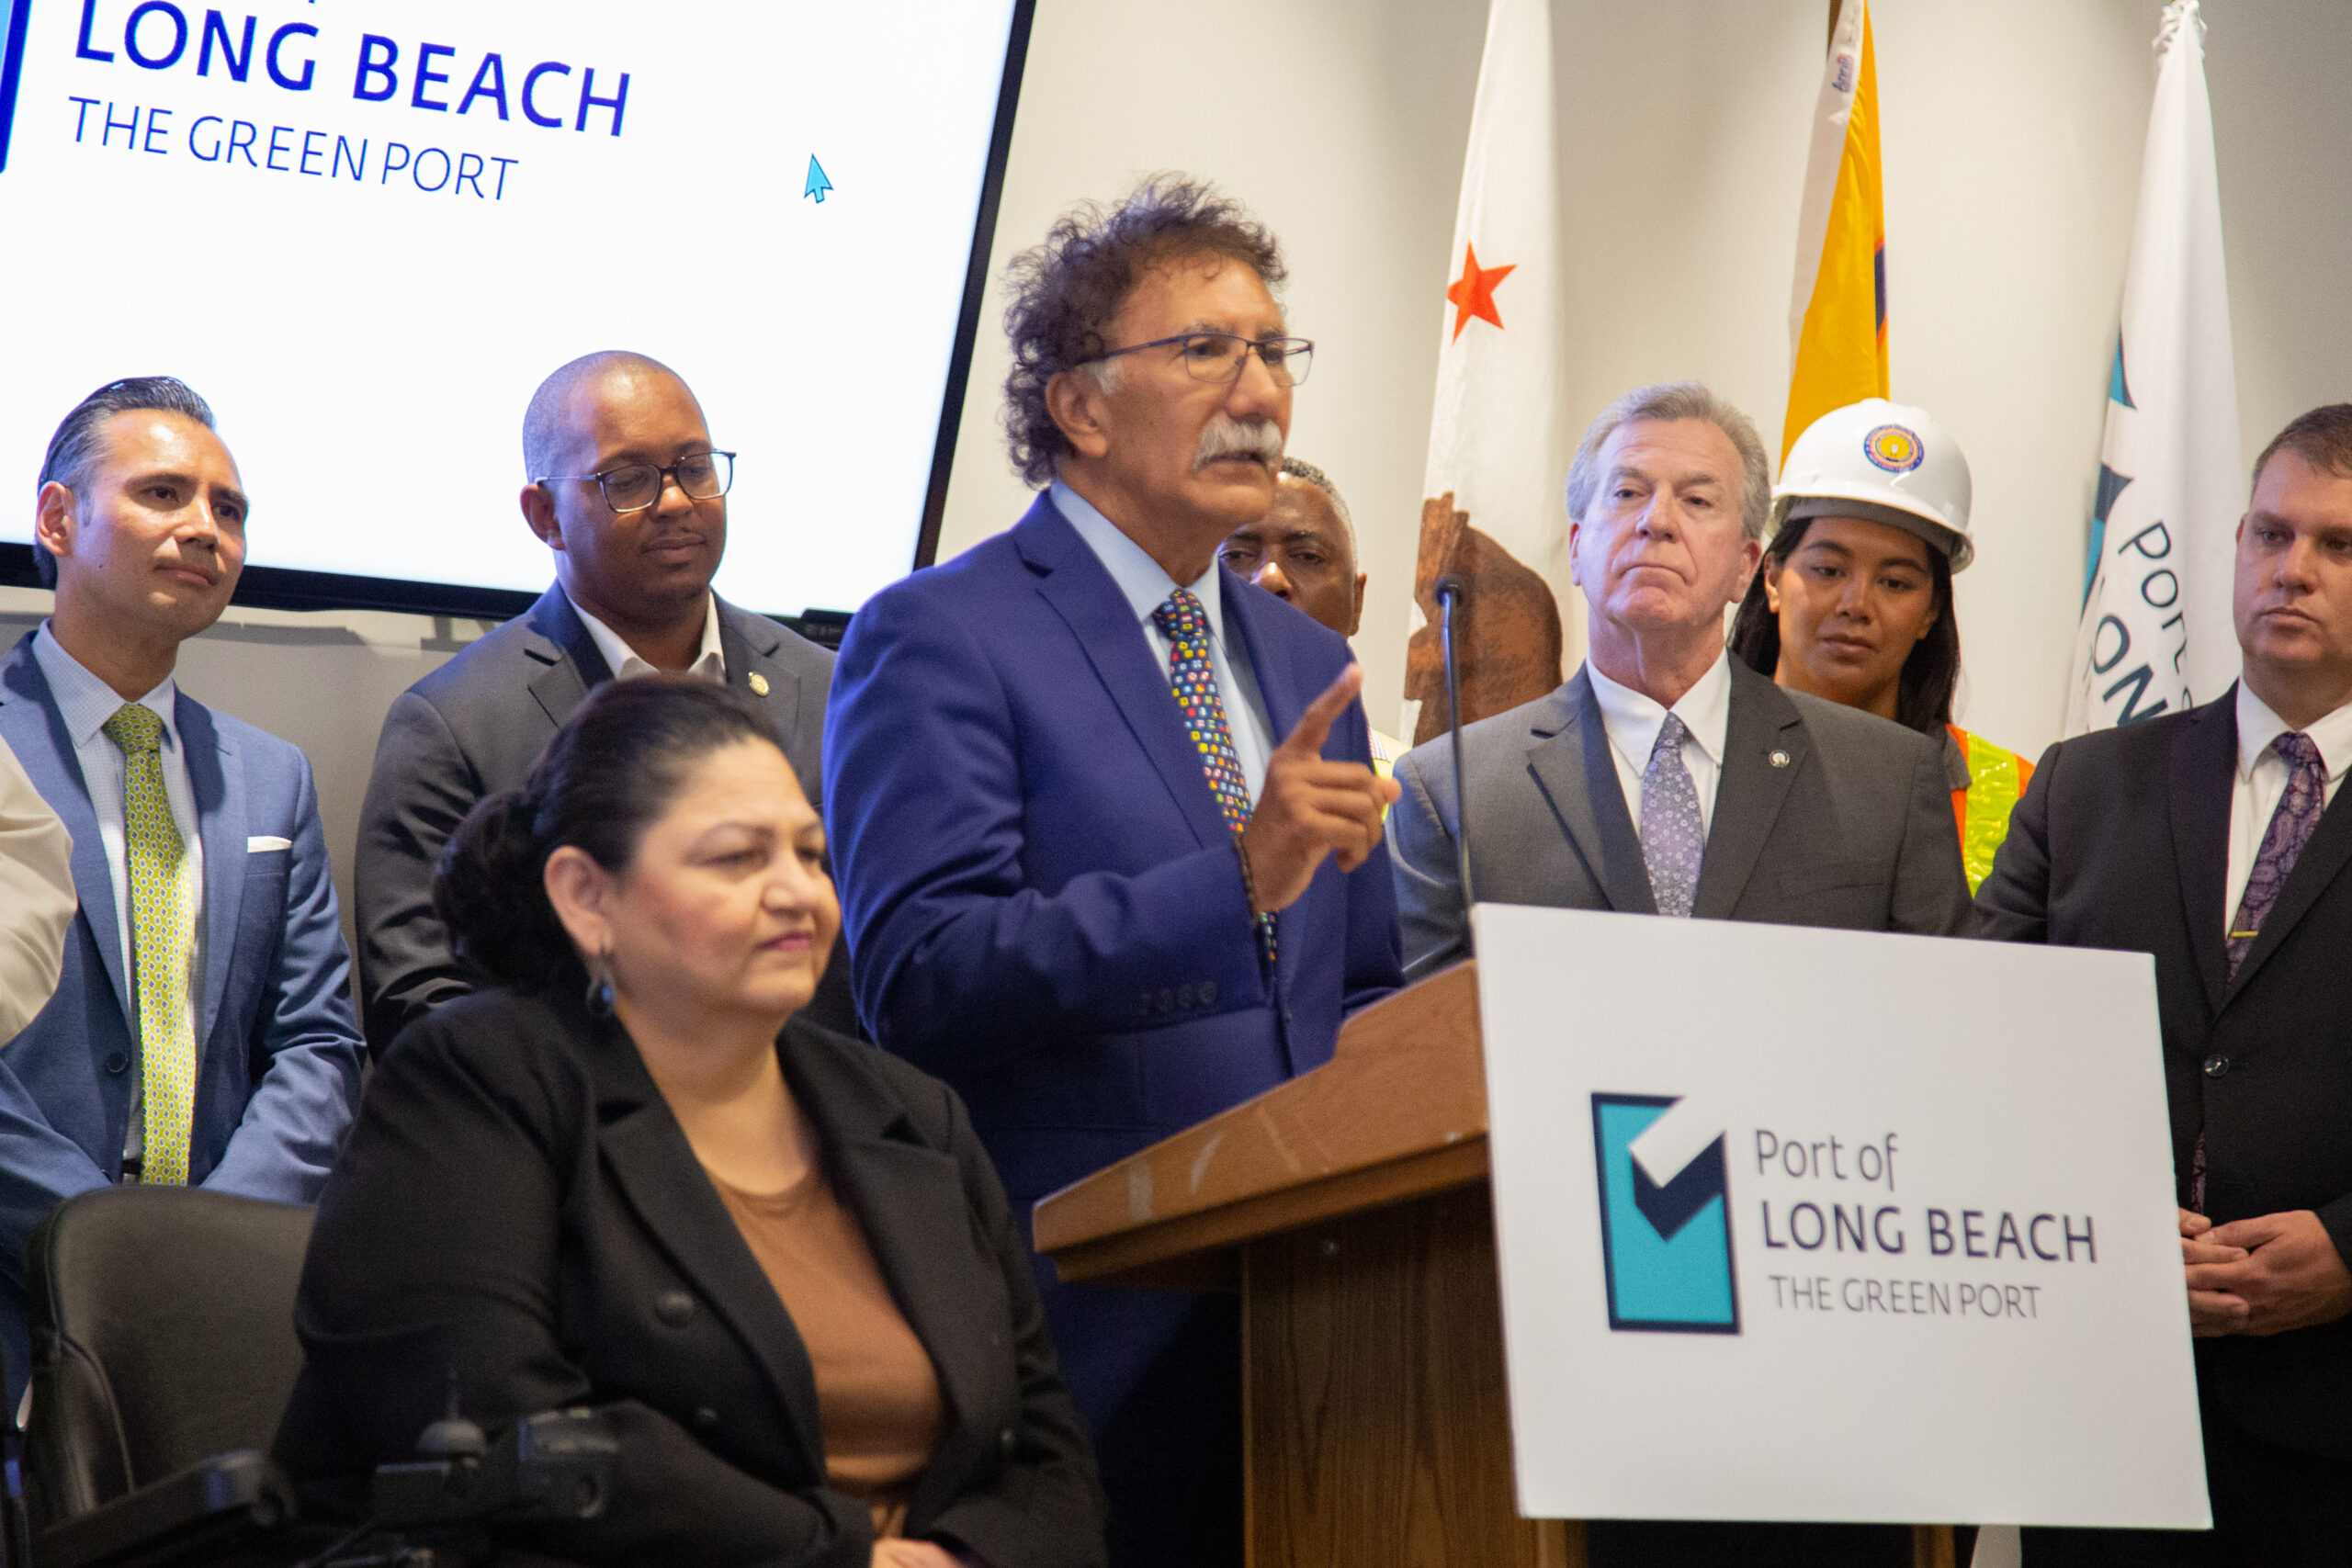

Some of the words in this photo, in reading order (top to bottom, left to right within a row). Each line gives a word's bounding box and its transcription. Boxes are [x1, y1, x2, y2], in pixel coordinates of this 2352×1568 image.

[74, 0, 320, 92] LONG
[352, 32, 631, 138] BEACH
[68, 96, 173, 155] THE
[188, 115, 368, 182] GREEN
[380, 141, 520, 201] PORT
[2092, 611, 2169, 728] ON
[1755, 1128, 1848, 1181] Port
[1858, 1132, 1898, 1192] of
[1760, 1199, 1906, 1256] LONG
[1926, 1206, 2098, 1264] BEACH
[1769, 1274, 1834, 1312] THE
[1843, 1278, 1951, 1316] GREEN
[1959, 1282, 2042, 1319] PORT
